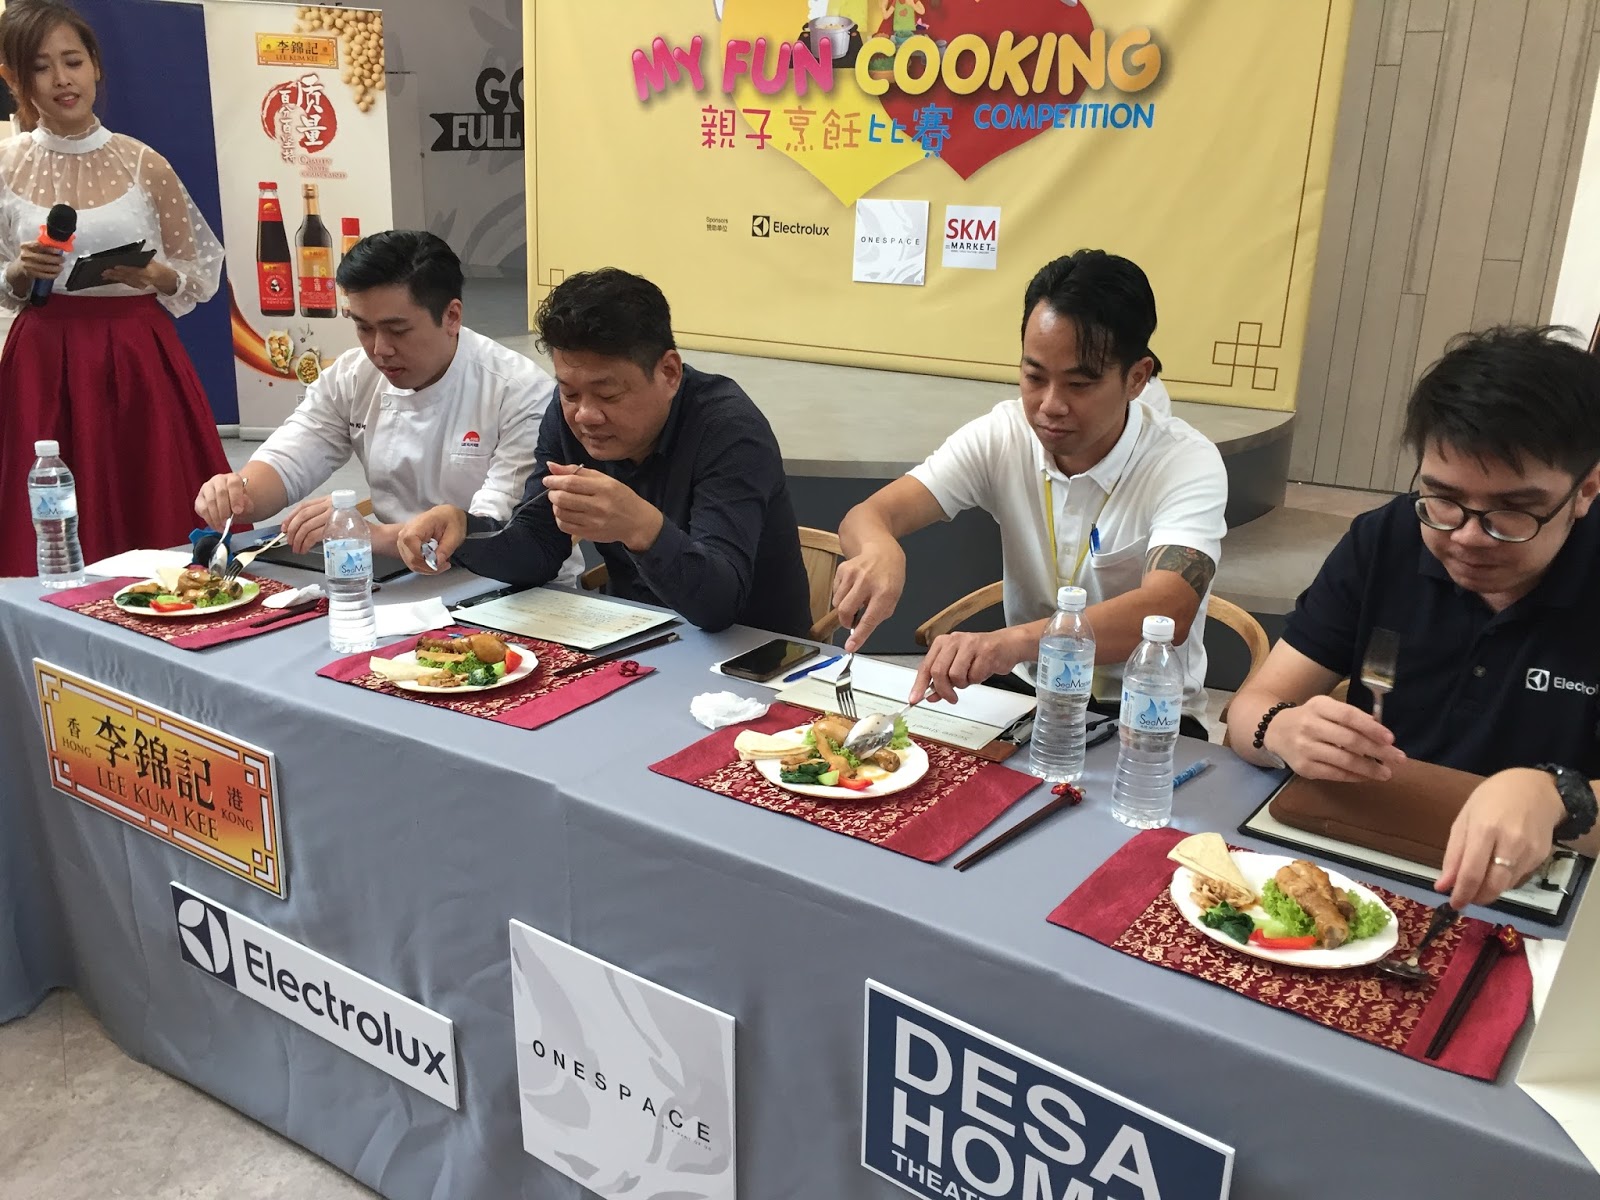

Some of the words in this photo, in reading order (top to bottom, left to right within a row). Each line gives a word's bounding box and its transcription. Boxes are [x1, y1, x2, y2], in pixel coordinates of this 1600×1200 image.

[632, 36, 704, 101] MY
[722, 37, 833, 96] FUN
[855, 28, 1161, 97] COOKING
[452, 115, 522, 148] FULL
[701, 103, 953, 158] 親子烹飪比賽
[974, 102, 1154, 130] COMPETITION
[773, 222, 829, 236] Electrolux
[860, 237, 921, 246] ONESPACE
[946, 218, 996, 241] SKM
[951, 242, 991, 251] MARKET
[66, 716, 82, 738] 香
[62, 737, 92, 759] HONG
[92, 714, 216, 811] 李錦記
[97, 766, 128, 796] LEE
[134, 778, 177, 820] KUM
[183, 804, 219, 841] KEE
[226, 785, 244, 813] 港
[220, 808, 254, 832] KONG
[243, 939, 449, 1085] Electrolux
[533, 1039, 711, 1143] ONESPACE
[894, 1015, 1162, 1200] DESA
[892, 1087, 1115, 1200] HOM
[891, 1149, 986, 1200] THEAT
